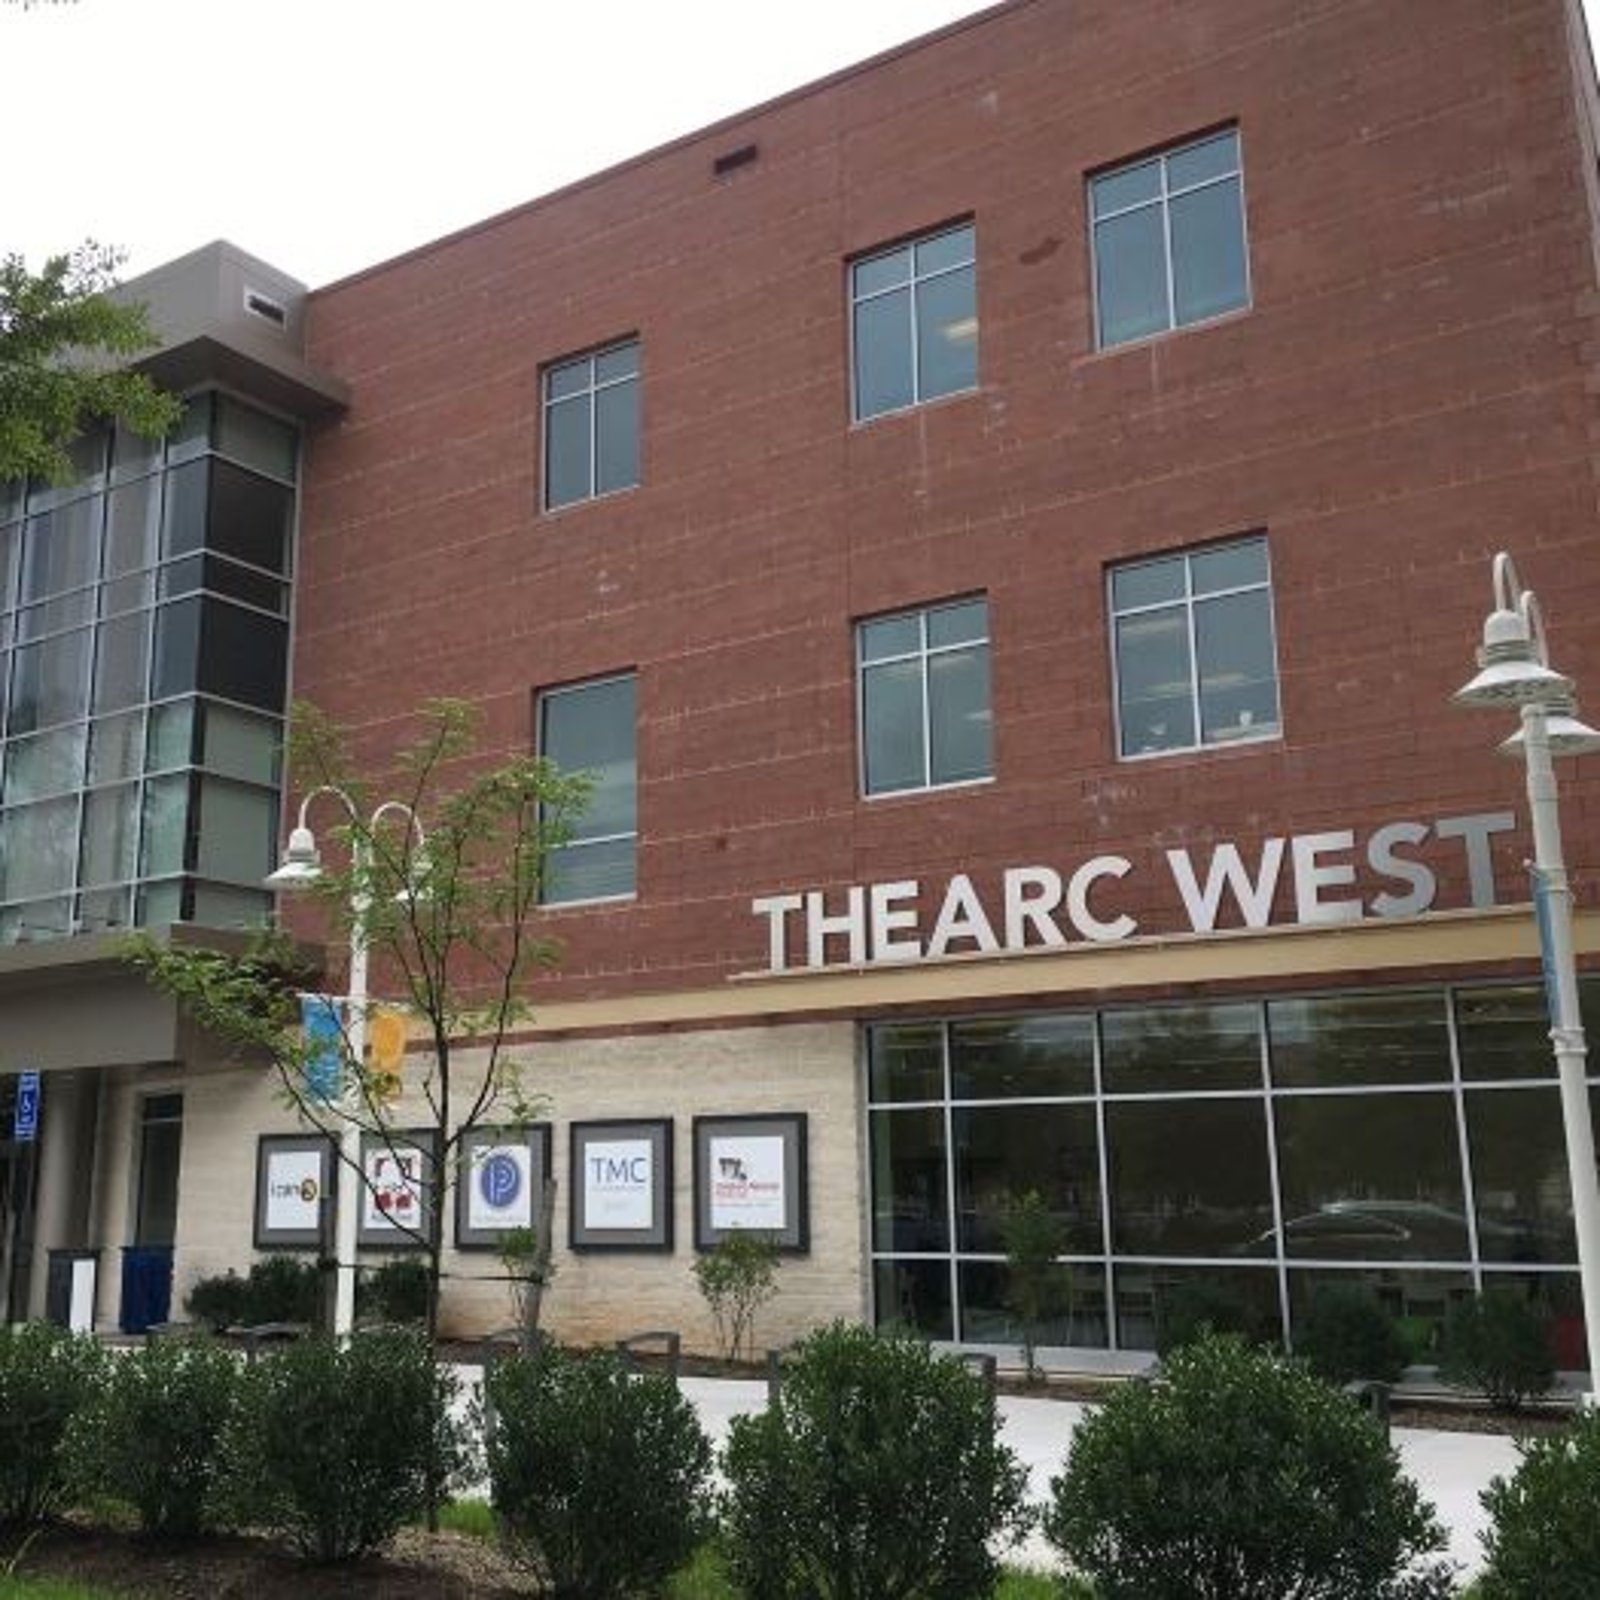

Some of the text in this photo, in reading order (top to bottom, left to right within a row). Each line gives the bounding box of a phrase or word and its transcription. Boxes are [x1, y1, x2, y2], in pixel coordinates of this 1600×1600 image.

[752, 813, 1516, 973] THEARC WEST
[590, 1157, 647, 1183] TMC
